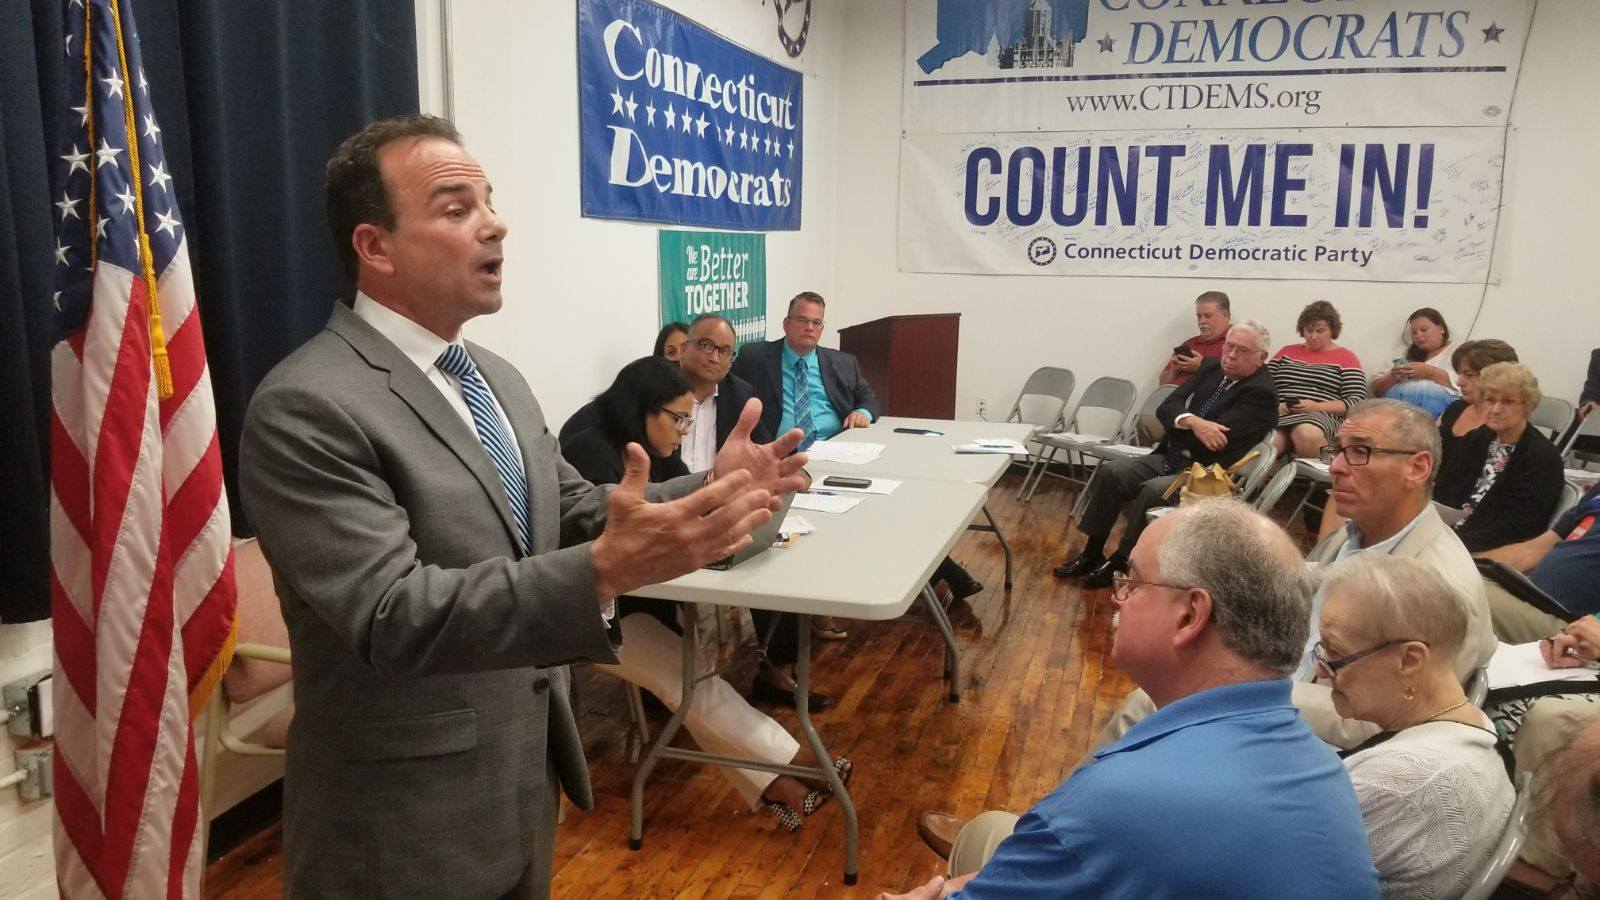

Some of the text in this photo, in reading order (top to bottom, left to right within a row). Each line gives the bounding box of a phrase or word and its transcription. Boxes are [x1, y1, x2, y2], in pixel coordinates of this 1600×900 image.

[1122, 11, 1470, 65] DEMOCRATS
[603, 19, 796, 131] Connecticut
[1067, 82, 1322, 115] www.CTDEMS.org
[606, 125, 792, 207] Democrats
[964, 145, 1186, 226] COUNT
[1204, 144, 1313, 227] ME
[1334, 143, 1435, 229] IN!
[685, 245, 698, 265] We
[699, 244, 749, 282] Better
[1064, 243, 1182, 262] Connecticut
[1189, 243, 1307, 263] Democratic
[1314, 245, 1373, 267] Party
[686, 267, 699, 281] are
[684, 281, 749, 316] TOGETHER
